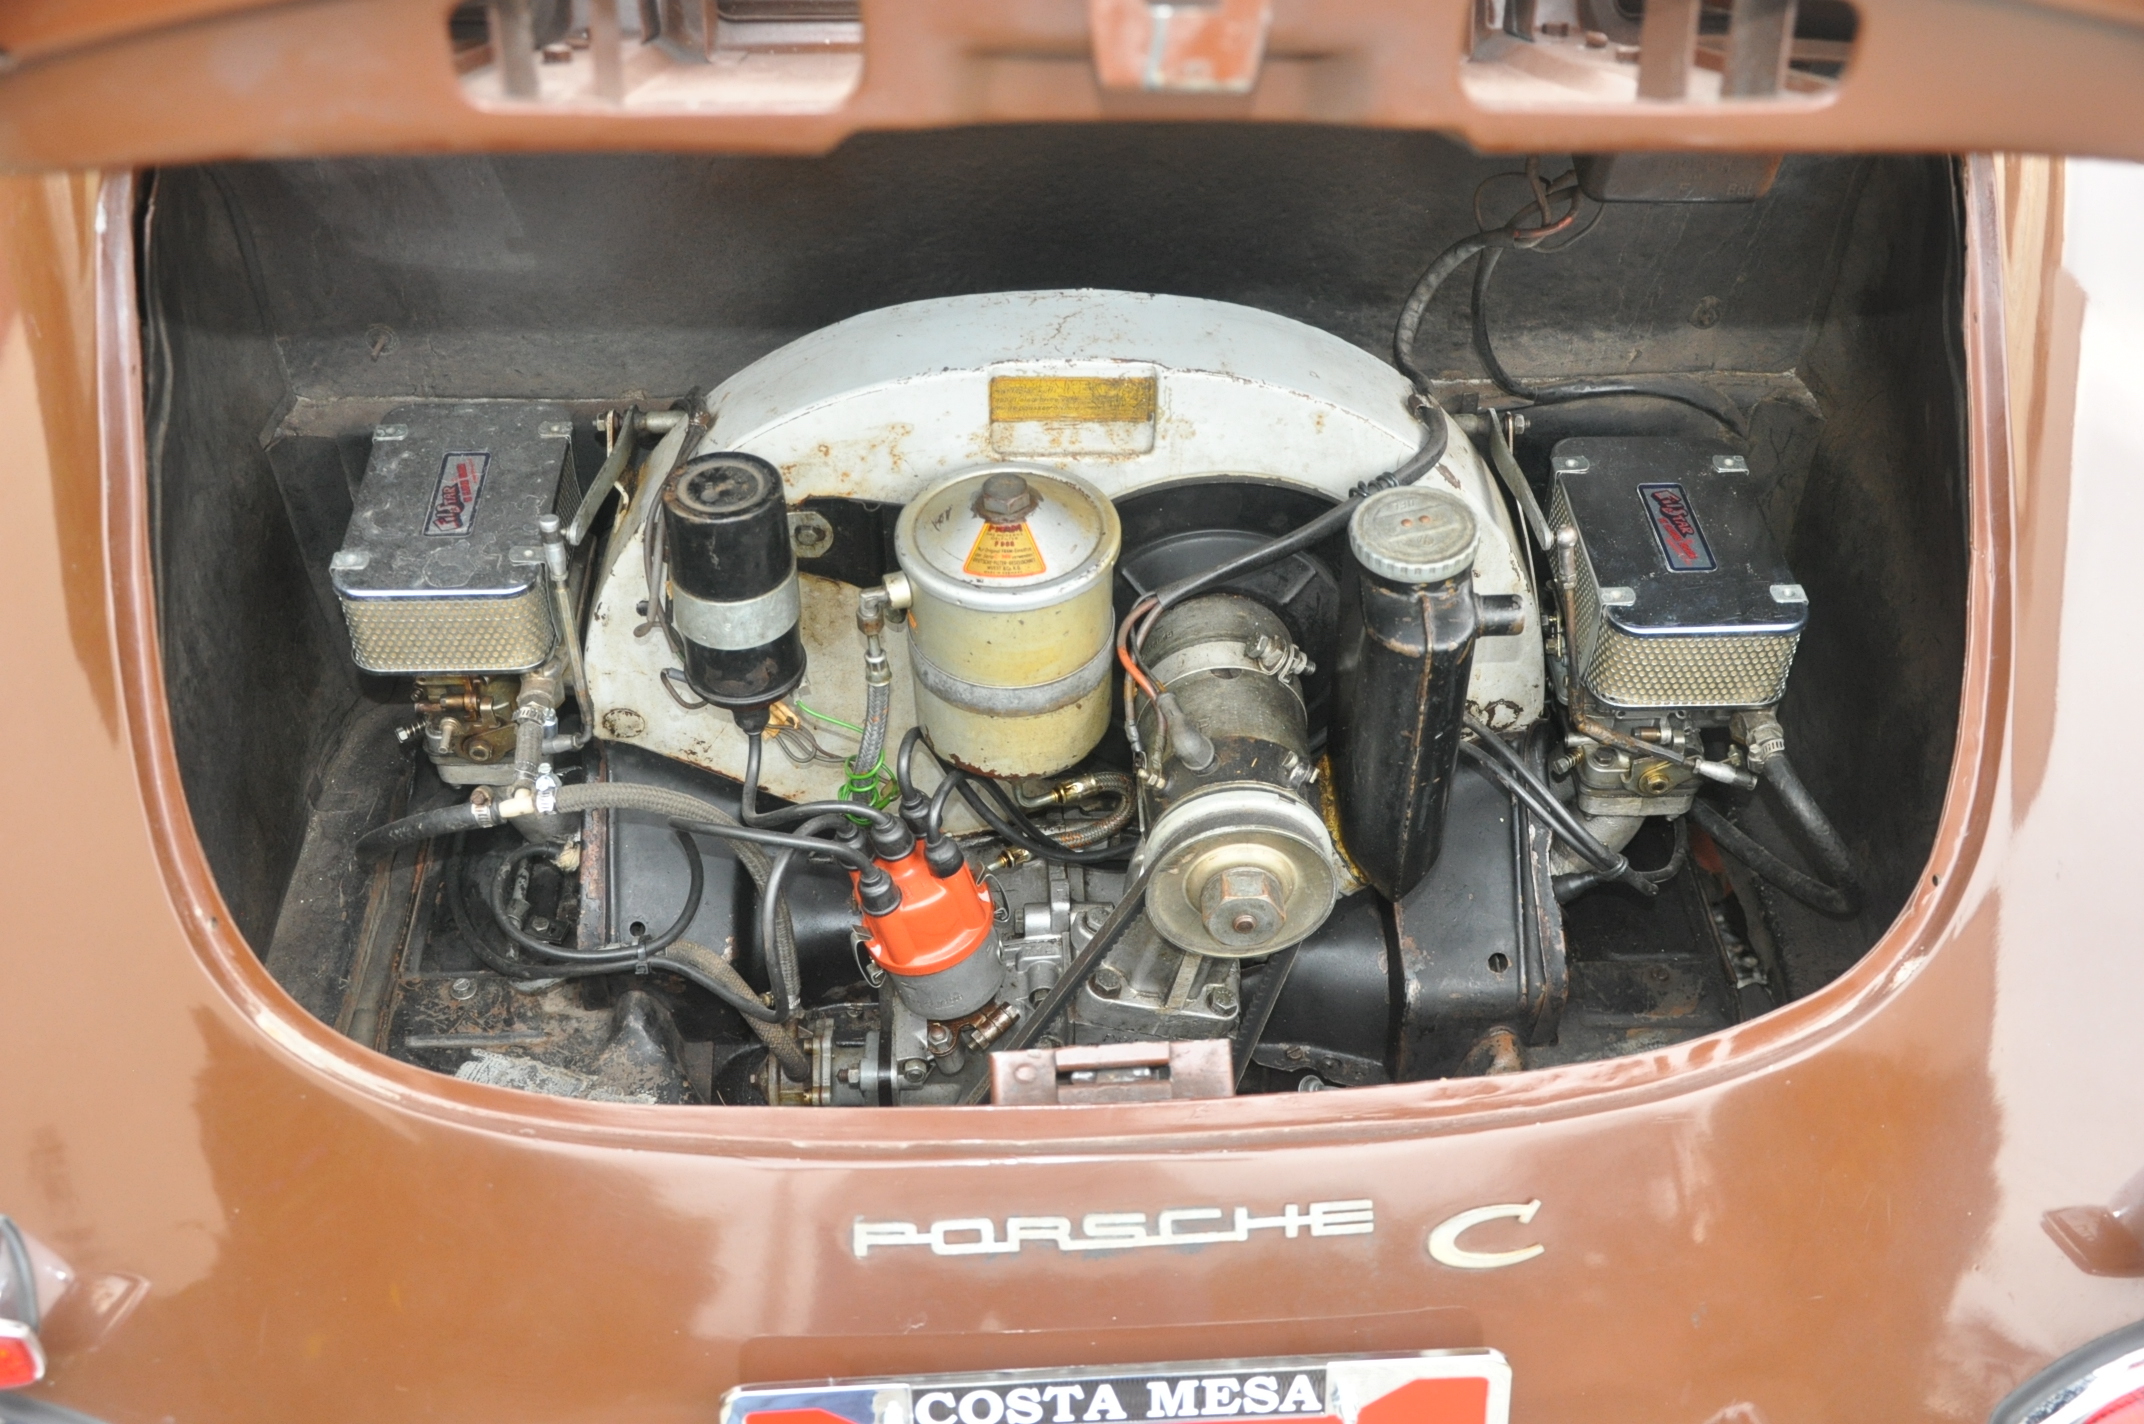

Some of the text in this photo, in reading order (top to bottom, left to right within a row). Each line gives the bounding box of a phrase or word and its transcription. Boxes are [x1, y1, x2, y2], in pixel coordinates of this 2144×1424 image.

[853, 1199, 1545, 1269] PORSCHE C
[914, 1374, 1323, 1424] COSTA MESA
